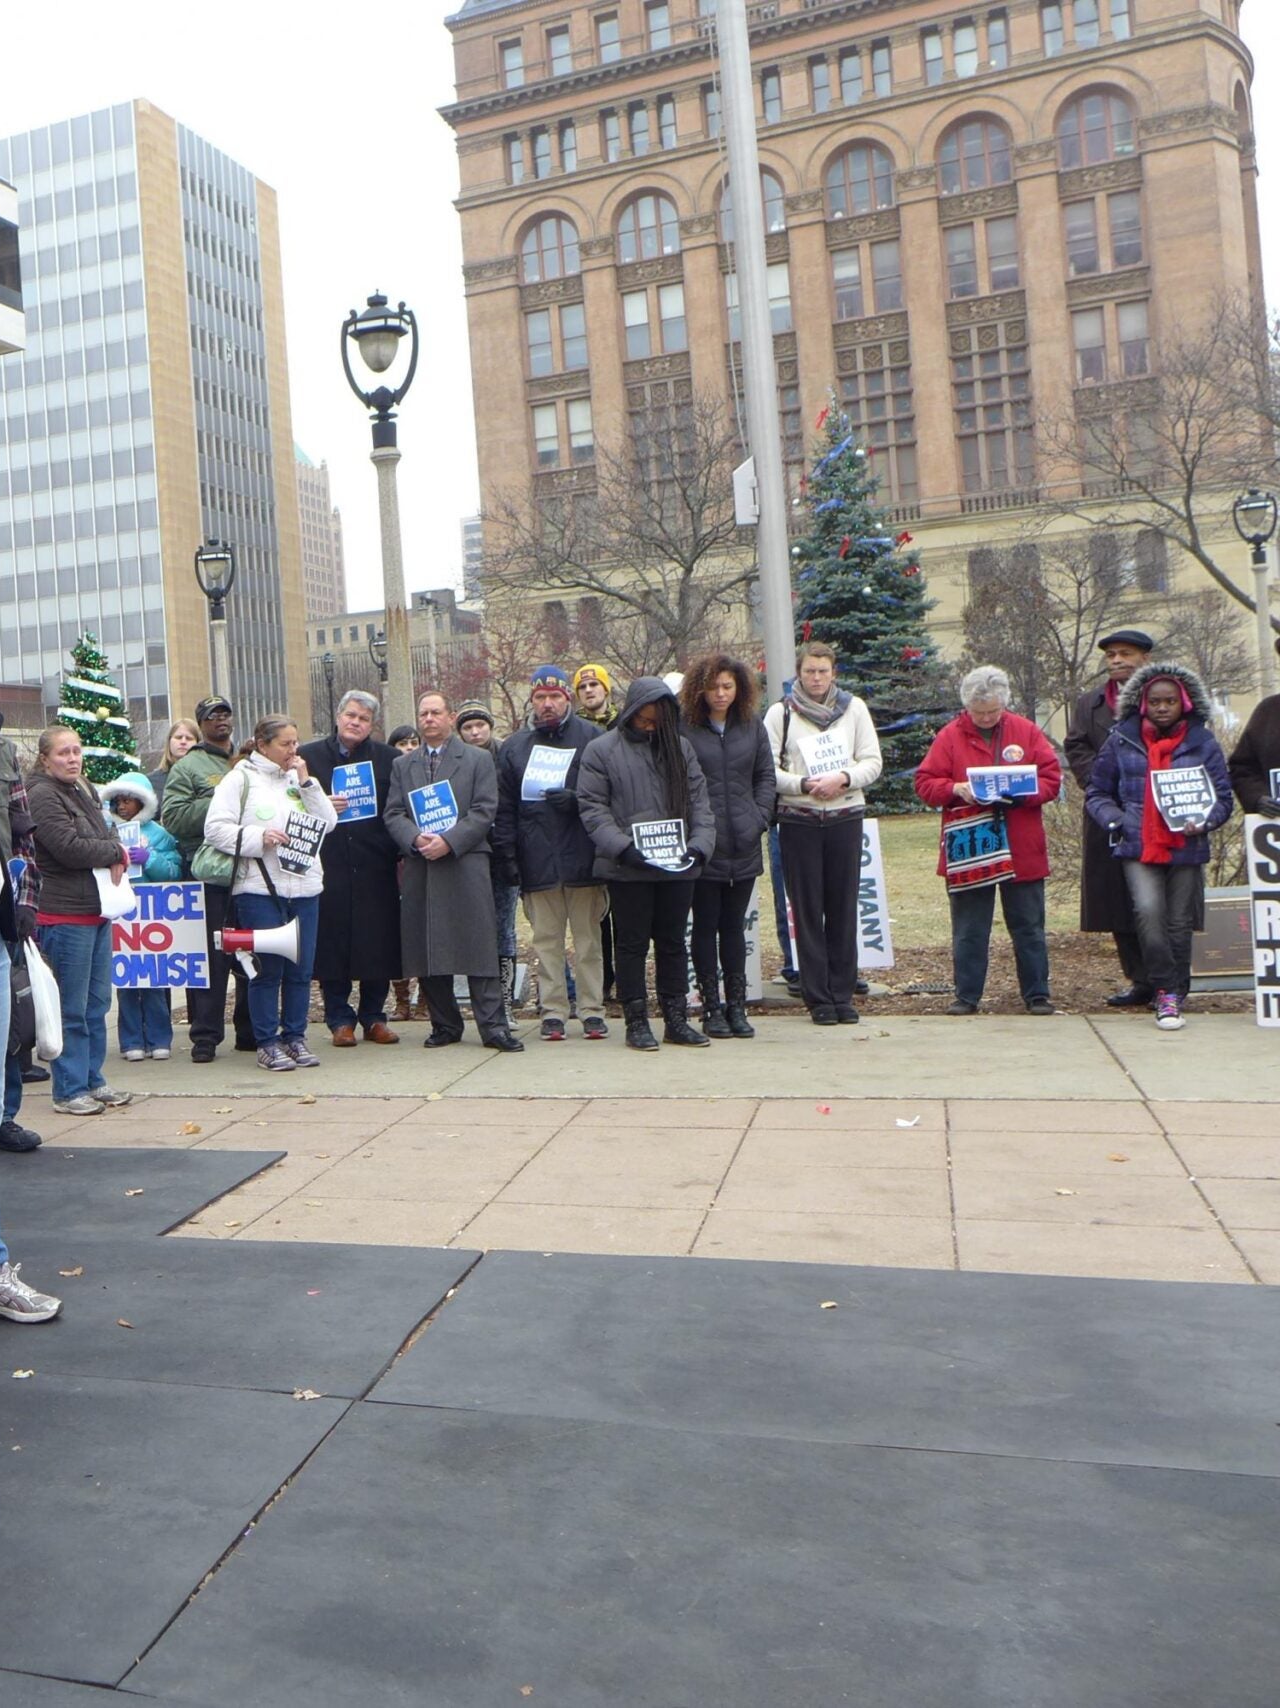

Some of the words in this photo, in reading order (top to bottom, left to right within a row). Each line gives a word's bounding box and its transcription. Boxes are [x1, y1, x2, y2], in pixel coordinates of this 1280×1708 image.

[816, 734, 833, 745] WE
[814, 745, 843, 760] CAN'T
[344, 766, 359, 776] WE
[1157, 770, 1204, 783] MENTAL
[346, 776, 362, 787] ARE
[1161, 781, 1205, 795] ILLNESS
[422, 785, 437, 799] WE
[1161, 795, 1173, 807] IS
[1173, 792, 1199, 804] NOT
[1201, 791, 1211, 802] A
[347, 796, 376, 807] MILTON
[425, 796, 442, 810] ARE
[290, 811, 316, 829] WHAT
[315, 820, 325, 831] IF
[419, 805, 453, 824] DONTRE
[288, 823, 301, 837] HE
[301, 828, 320, 843] WAS
[639, 822, 679, 836] MENTAL
[289, 837, 313, 854] YOUR
[642, 835, 679, 848] ILLNESS
[642, 849, 653, 859] IS
[653, 847, 674, 858] NOT
[675, 846, 684, 856] A
[124, 884, 204, 921] TICE
[858, 877, 885, 953] MANY
[112, 923, 173, 952] NO
[112, 953, 207, 988] OMISE
